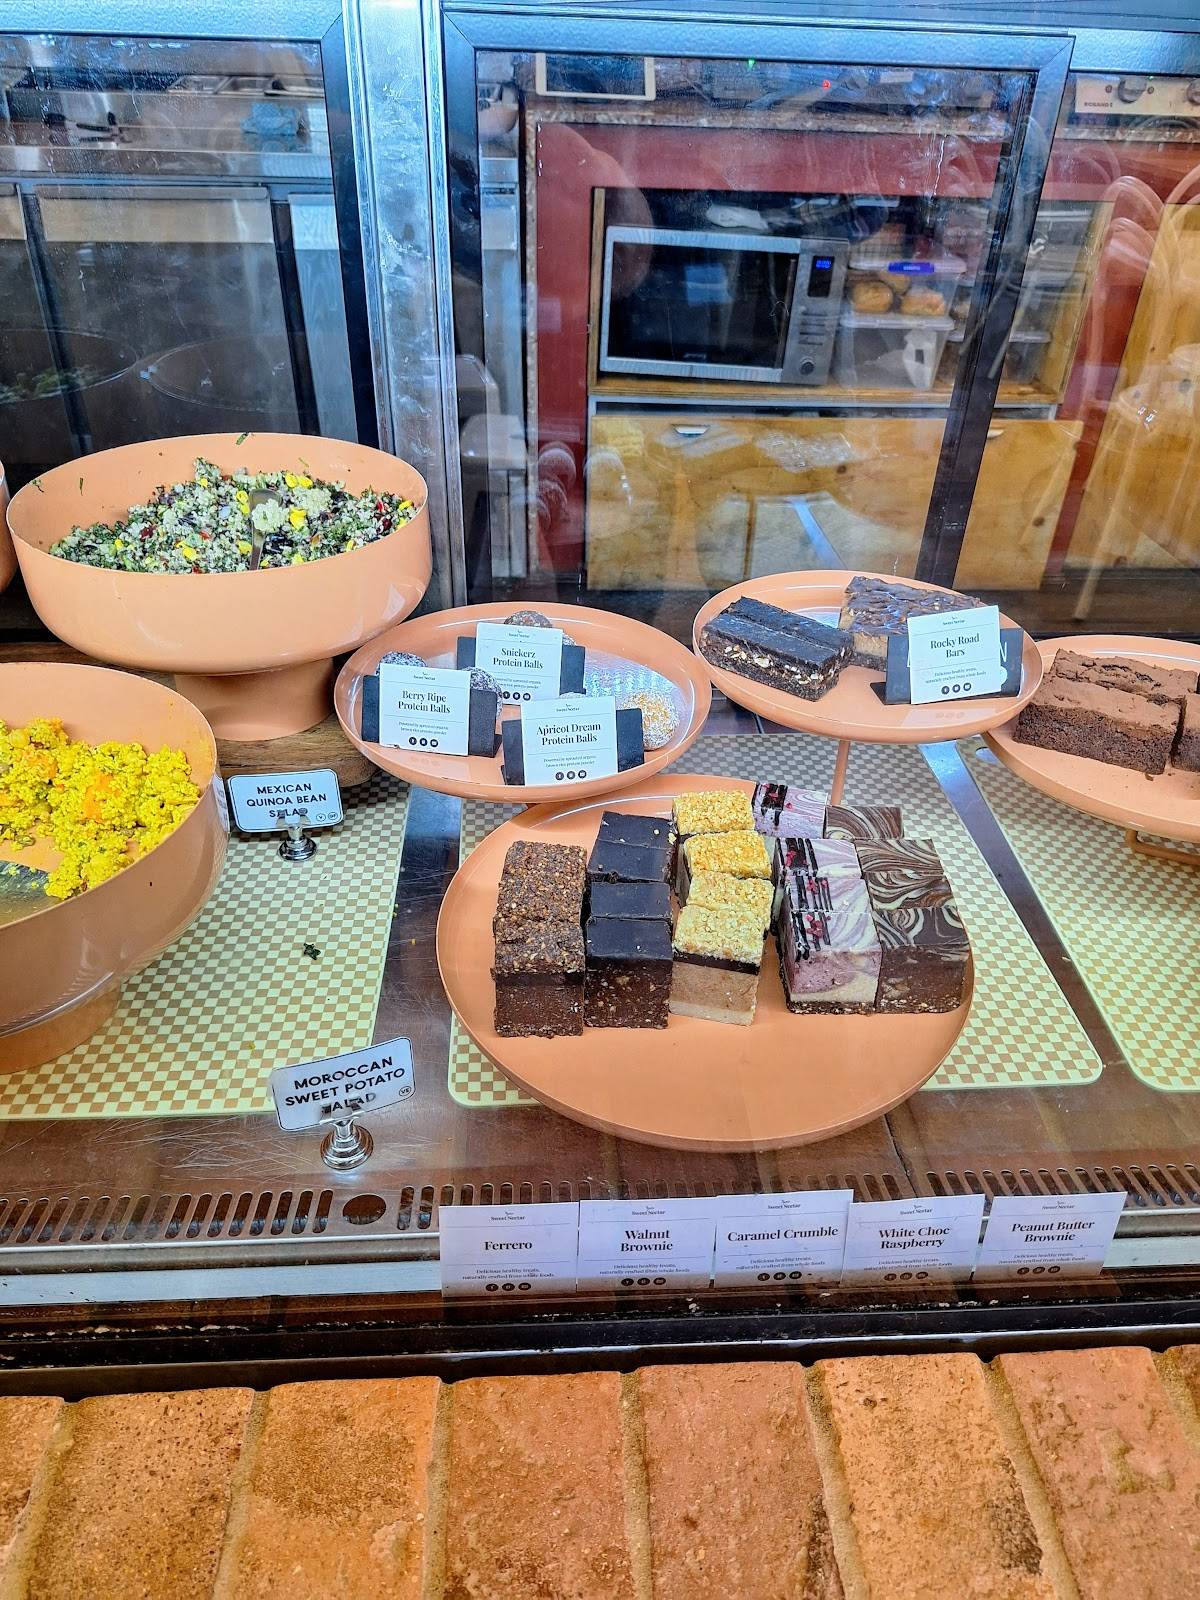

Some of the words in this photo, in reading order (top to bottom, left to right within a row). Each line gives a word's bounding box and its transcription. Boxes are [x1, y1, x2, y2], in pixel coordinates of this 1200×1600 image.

[930, 637, 956, 649] Rocky
[958, 633, 980, 645] Road
[501, 647, 536, 658] Snickerz
[946, 649, 965, 658] Bars
[493, 657, 522, 668] Protein
[524, 660, 543, 669] Balls
[402, 690, 426, 701] Berry
[428, 692, 447, 703] Ripe
[398, 701, 428, 712] Protein
[430, 703, 451, 713] Balls
[537, 724, 569, 736] Apricot
[572, 723, 601, 733] Dream
[542, 735, 574, 746] Protein
[576, 733, 598, 743] Balls
[257, 783, 312, 795] MEXICAN
[246, 796, 293, 807] QUINOA
[296, 794, 327, 804] BEAN
[294, 1056, 392, 1090] MOROCCAN
[285, 1086, 339, 1106] SWEET
[345, 1067, 405, 1093] POTATO
[321, 1092, 376, 1114] ALAD
[1012, 1222, 1054, 1232] Peanut
[1057, 1220, 1095, 1230] Butter
[625, 1230, 670, 1240] Walnut
[728, 1229, 780, 1242] Caramel
[784, 1226, 838, 1239] Crumble
[879, 1228, 915, 1239] White
[918, 1226, 950, 1236] Choc
[1024, 1232, 1076, 1243] Brownie
[484, 1241, 533, 1251] Ferrero
[621, 1241, 673, 1252] Brownie
[881, 1239, 944, 1250] Raspberry
